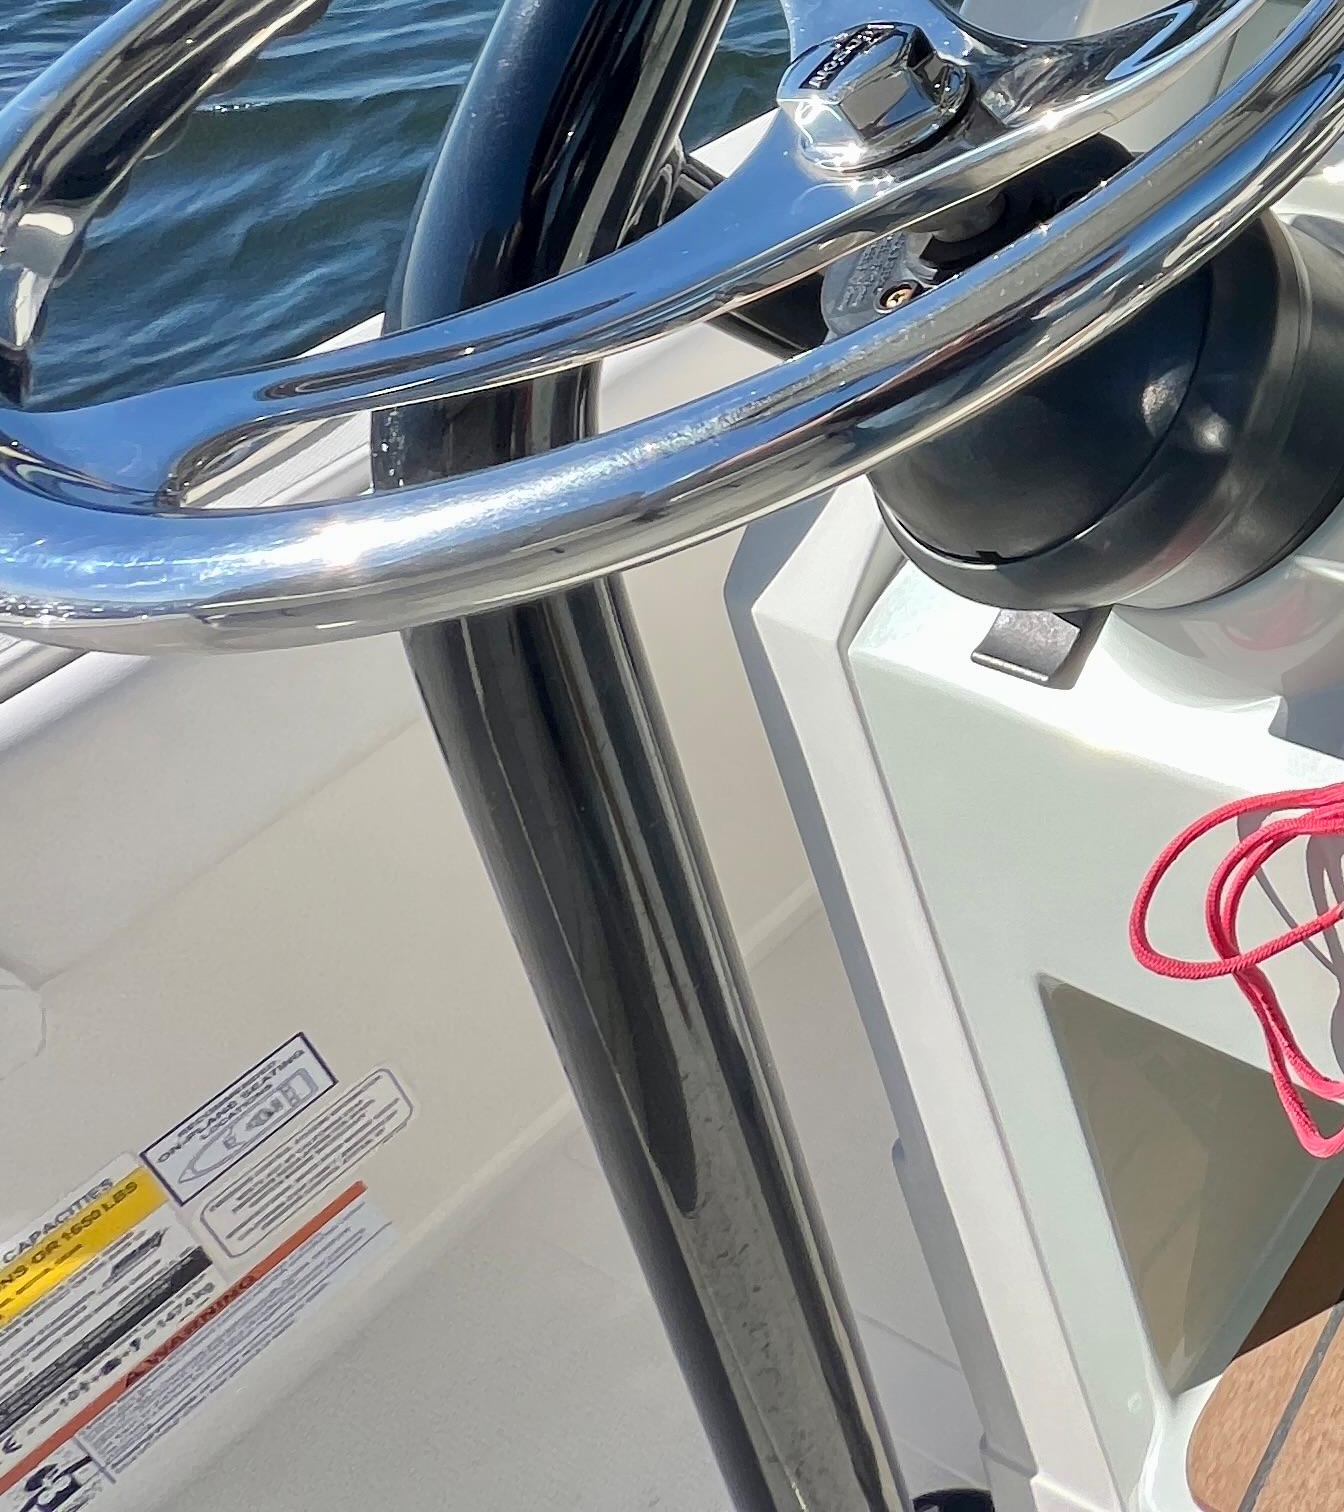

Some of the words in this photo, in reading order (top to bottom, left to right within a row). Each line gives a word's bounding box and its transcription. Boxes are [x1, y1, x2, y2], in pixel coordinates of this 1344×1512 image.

[240, 1049, 305, 1098] SEATING
[31, 1240, 61, 1264] OR
[101, 1181, 137, 1212] LBS
